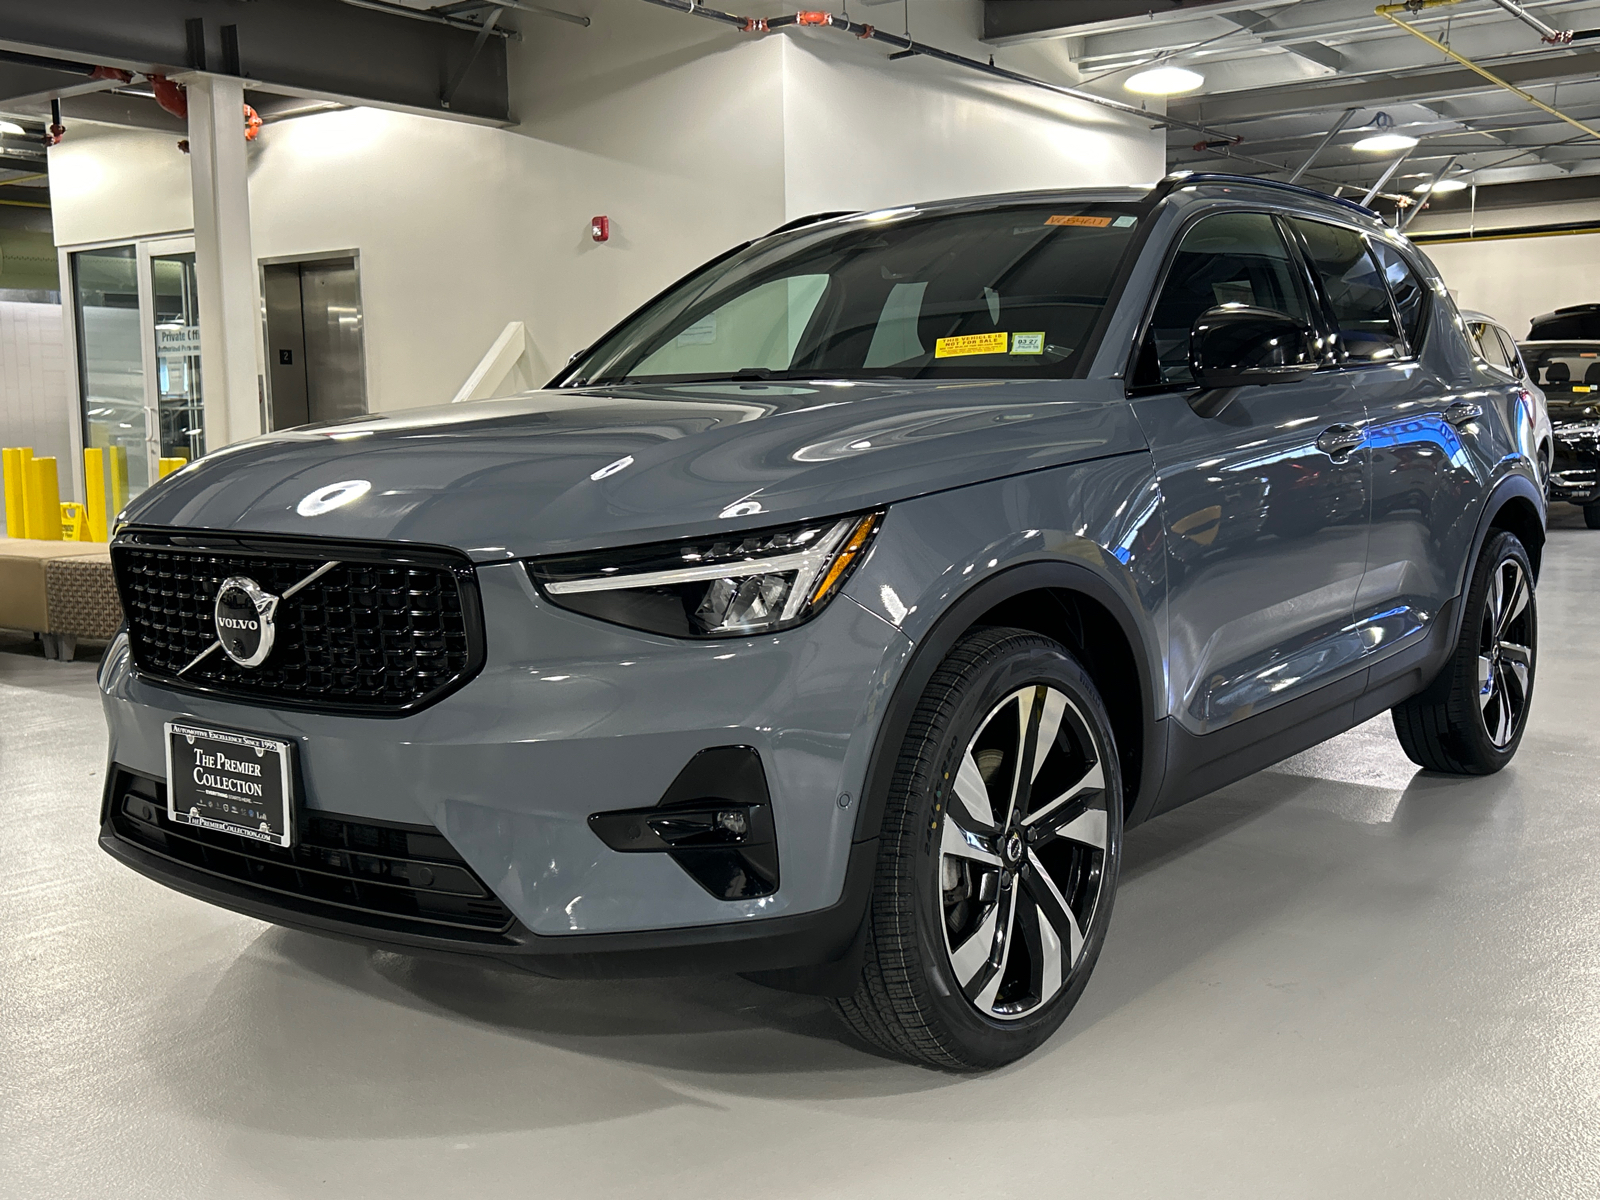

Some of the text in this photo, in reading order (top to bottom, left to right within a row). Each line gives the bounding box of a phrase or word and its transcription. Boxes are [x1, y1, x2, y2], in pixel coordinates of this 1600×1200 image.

[161, 331, 186, 342] Private
[961, 334, 992, 342] VEHICLE
[283, 351, 289, 361] 2
[217, 616, 258, 631] VOLVO
[260, 739, 277, 750] 1995
[205, 789, 229, 799] EVERYTHING
